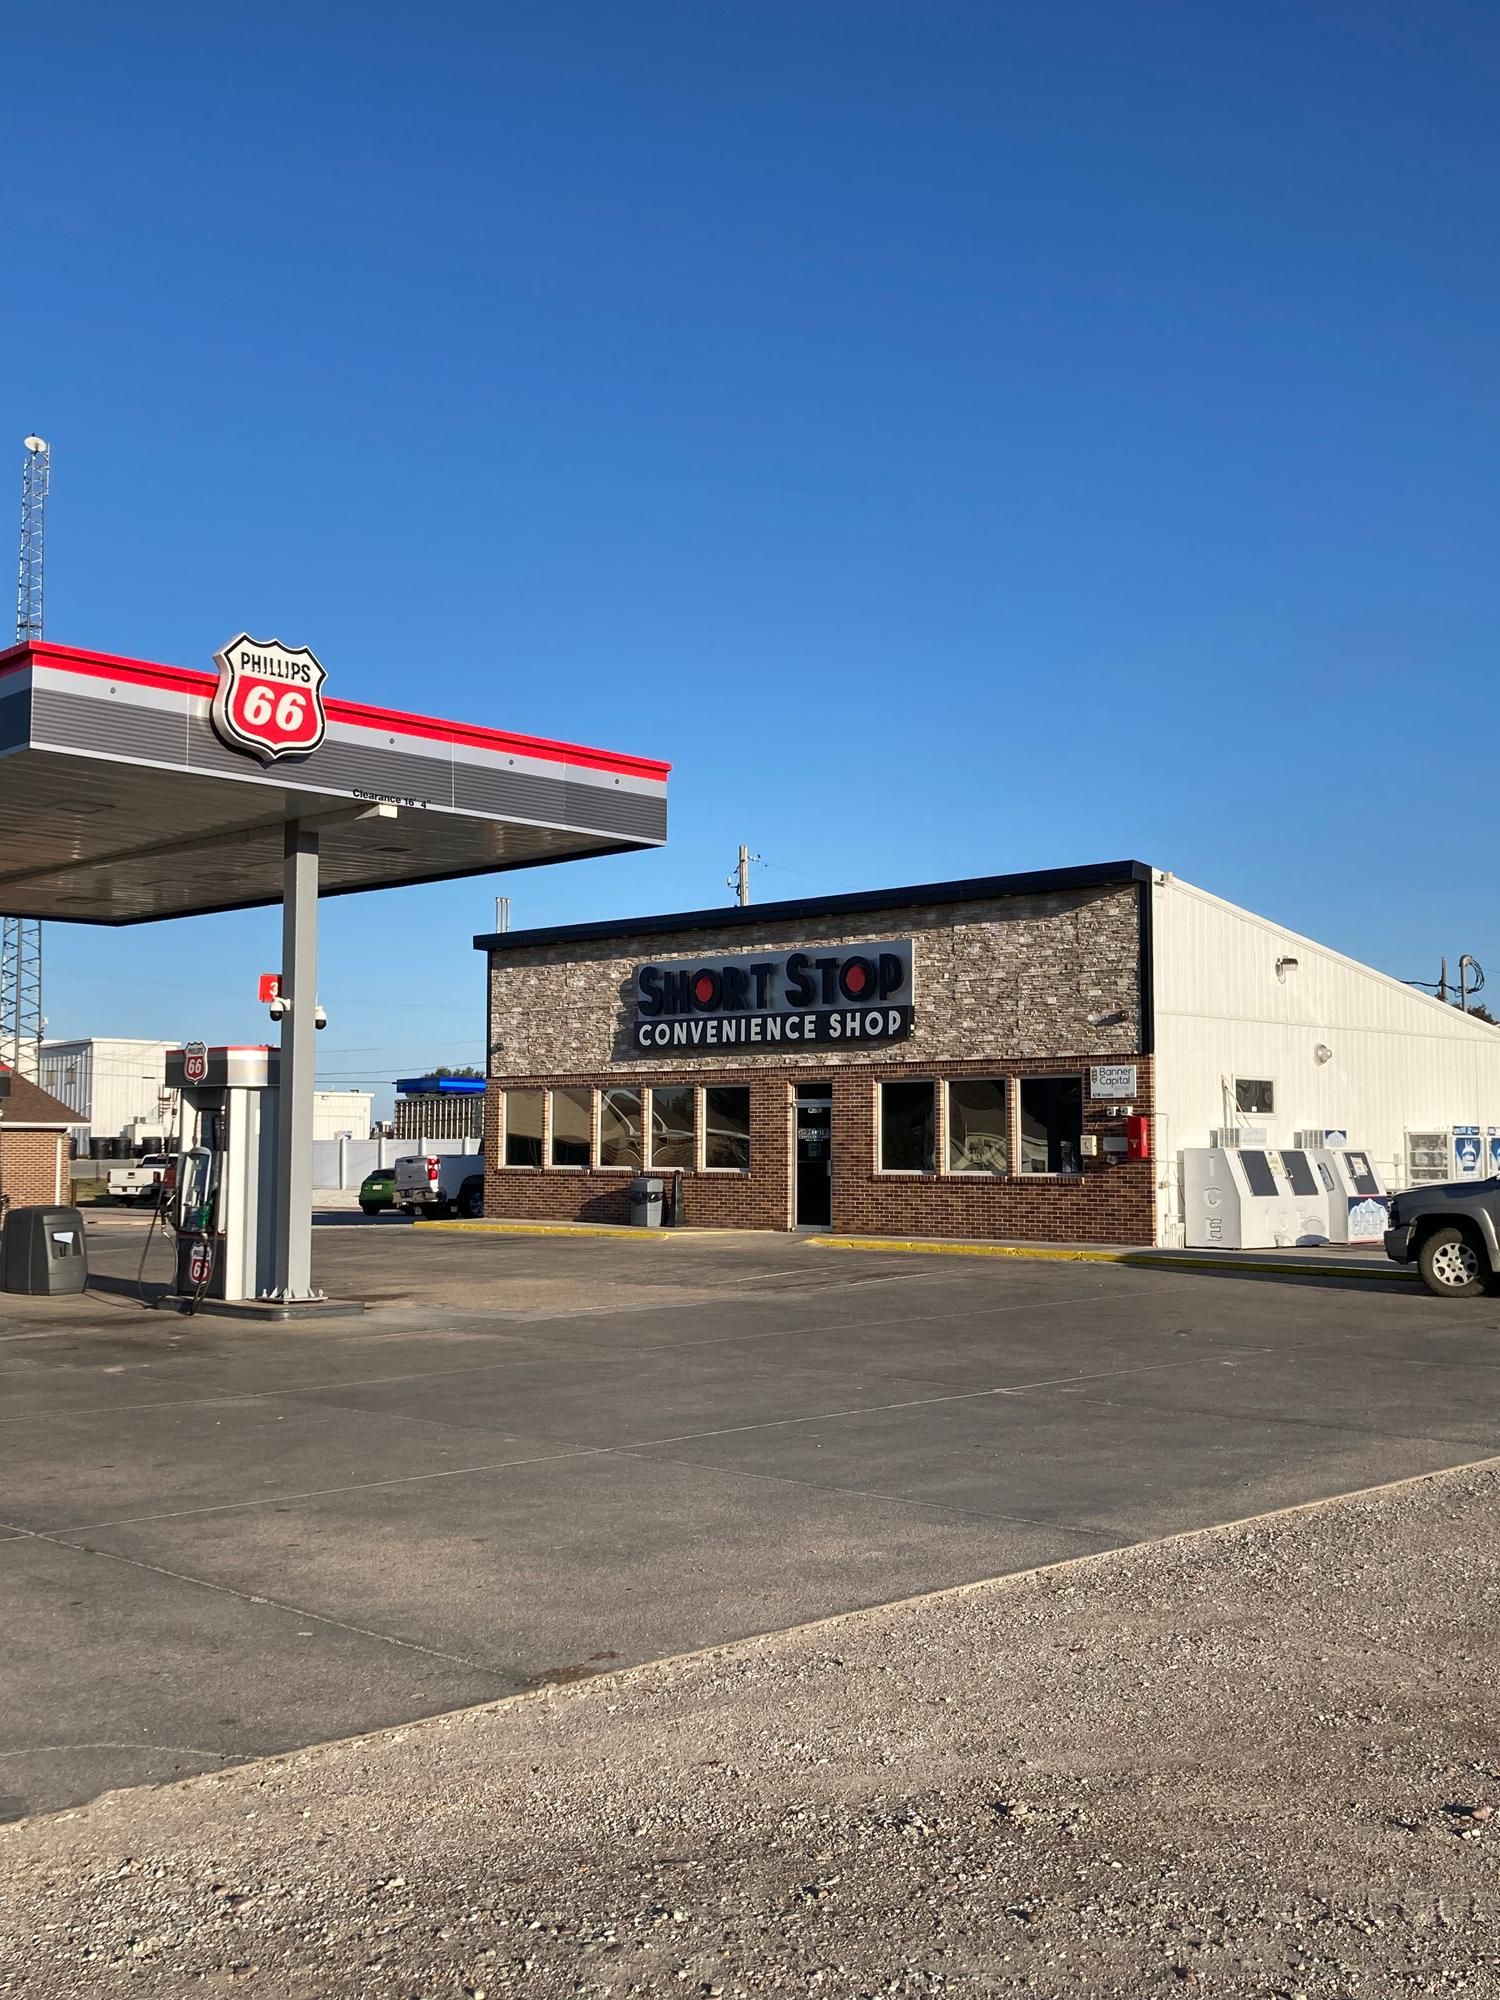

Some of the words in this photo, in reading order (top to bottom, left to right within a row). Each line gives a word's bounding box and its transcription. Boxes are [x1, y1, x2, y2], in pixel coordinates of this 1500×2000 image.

[240, 651, 311, 682] PHILLIPS
[243, 685, 307, 731] 66
[352, 788, 401, 804] Clearance
[269, 981, 279, 996] 3
[637, 962, 774, 1017] SHORT
[785, 952, 904, 1008] STOP
[638, 1014, 817, 1047] CONVENIENCE
[828, 1009, 902, 1039] SHOP
[188, 1058, 202, 1074] 66
[1099, 1067, 1133, 1077] Banner
[1099, 1076, 1131, 1088] Capital
